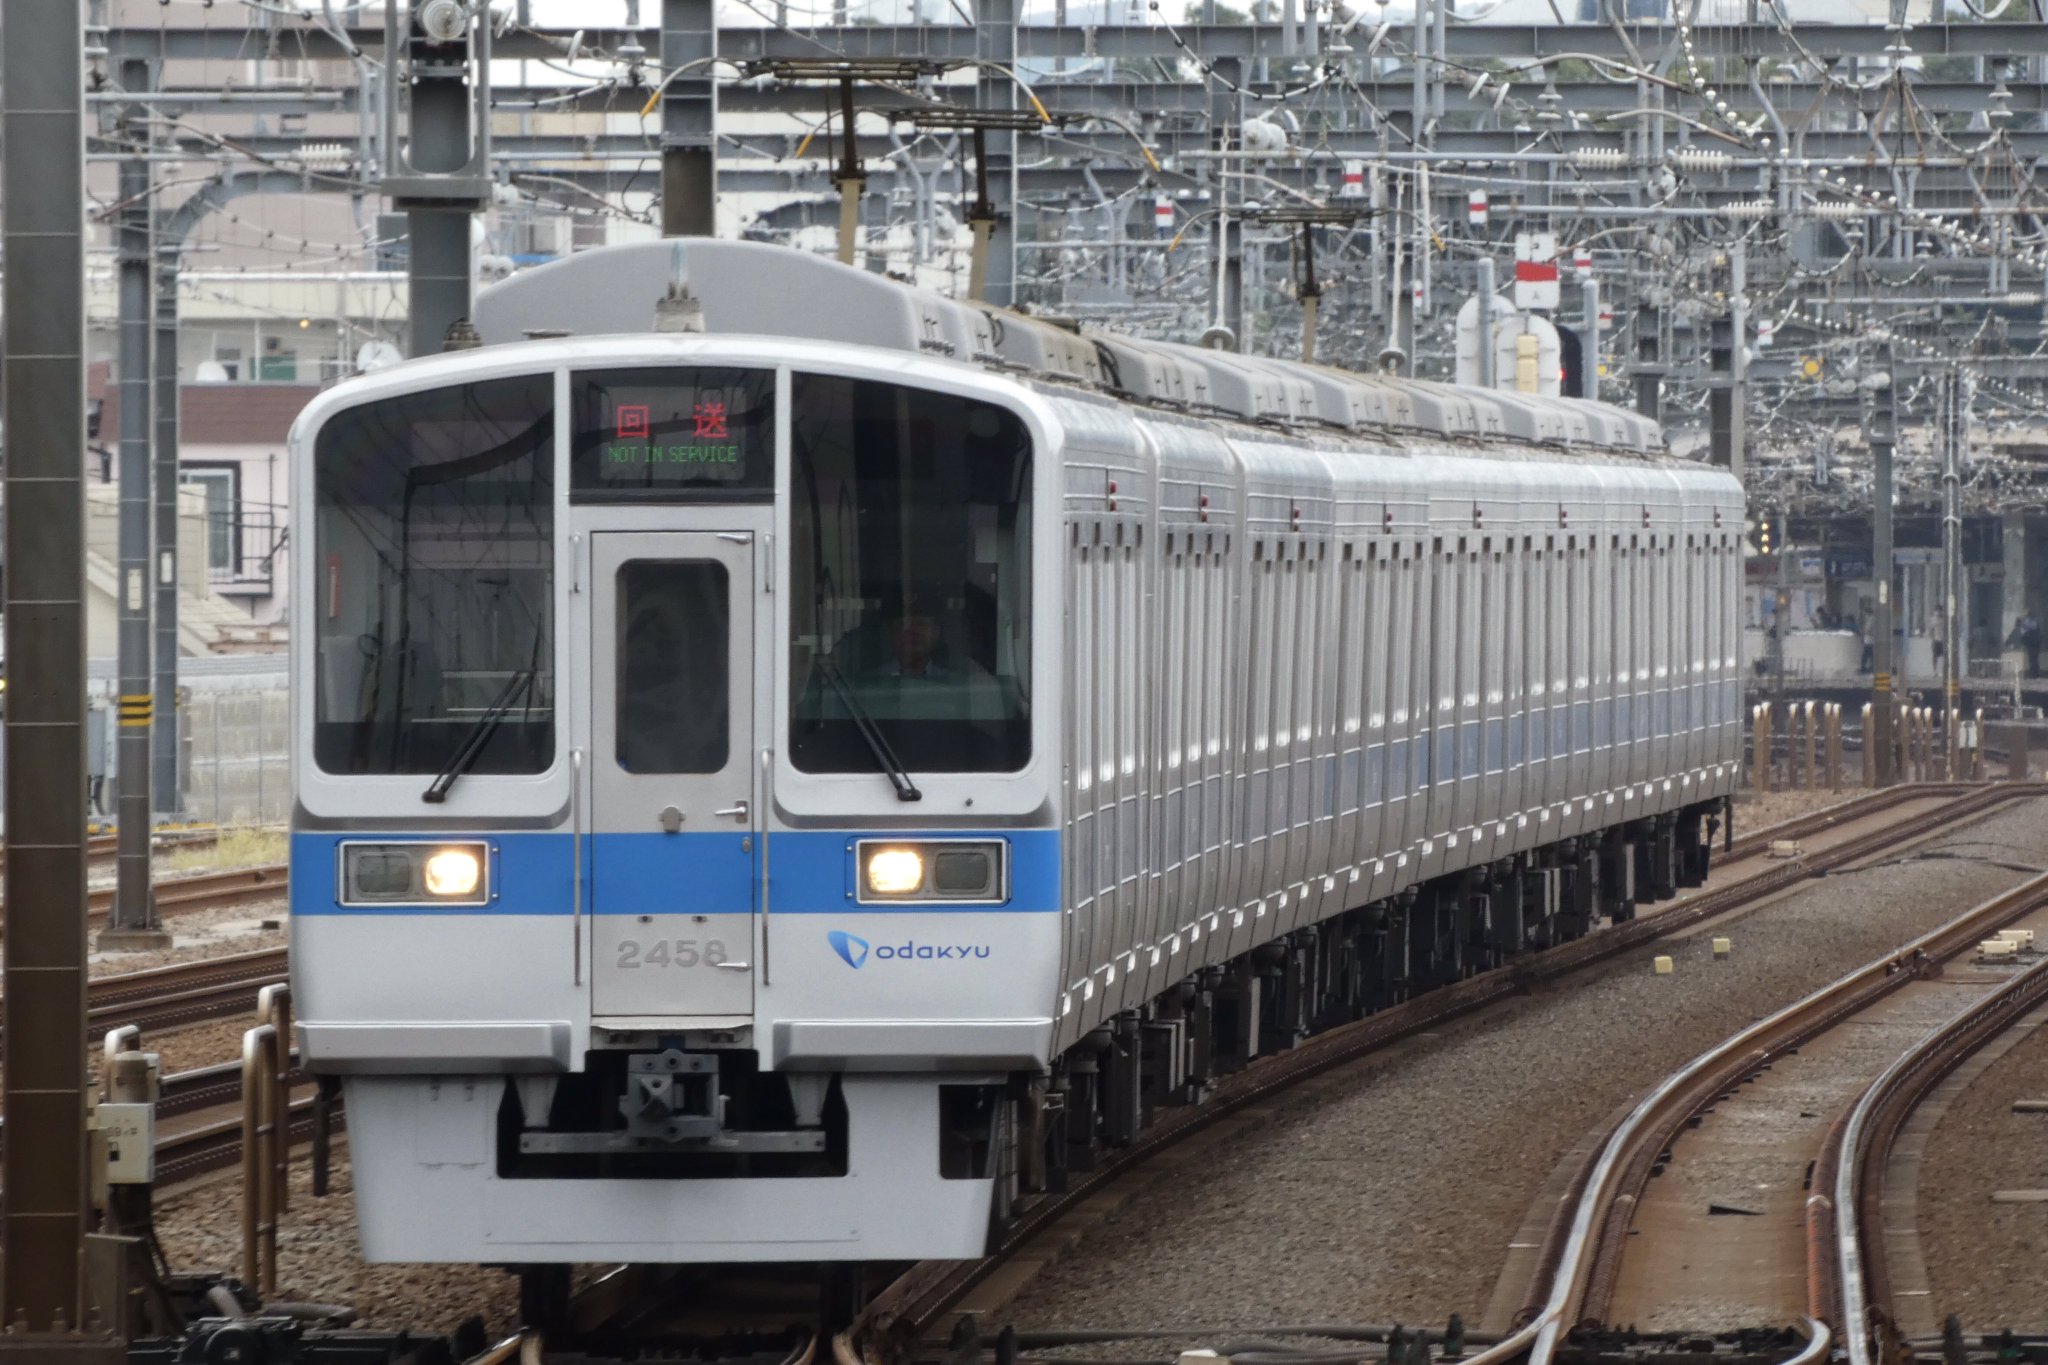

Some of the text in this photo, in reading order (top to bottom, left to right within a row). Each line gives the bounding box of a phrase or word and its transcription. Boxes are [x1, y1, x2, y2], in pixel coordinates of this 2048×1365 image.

[617, 402, 730, 438] 回送
[608, 446, 738, 463] NOT IN SERVICE
[616, 939, 728, 968] 2458
[876, 940, 990, 959] odakyu
